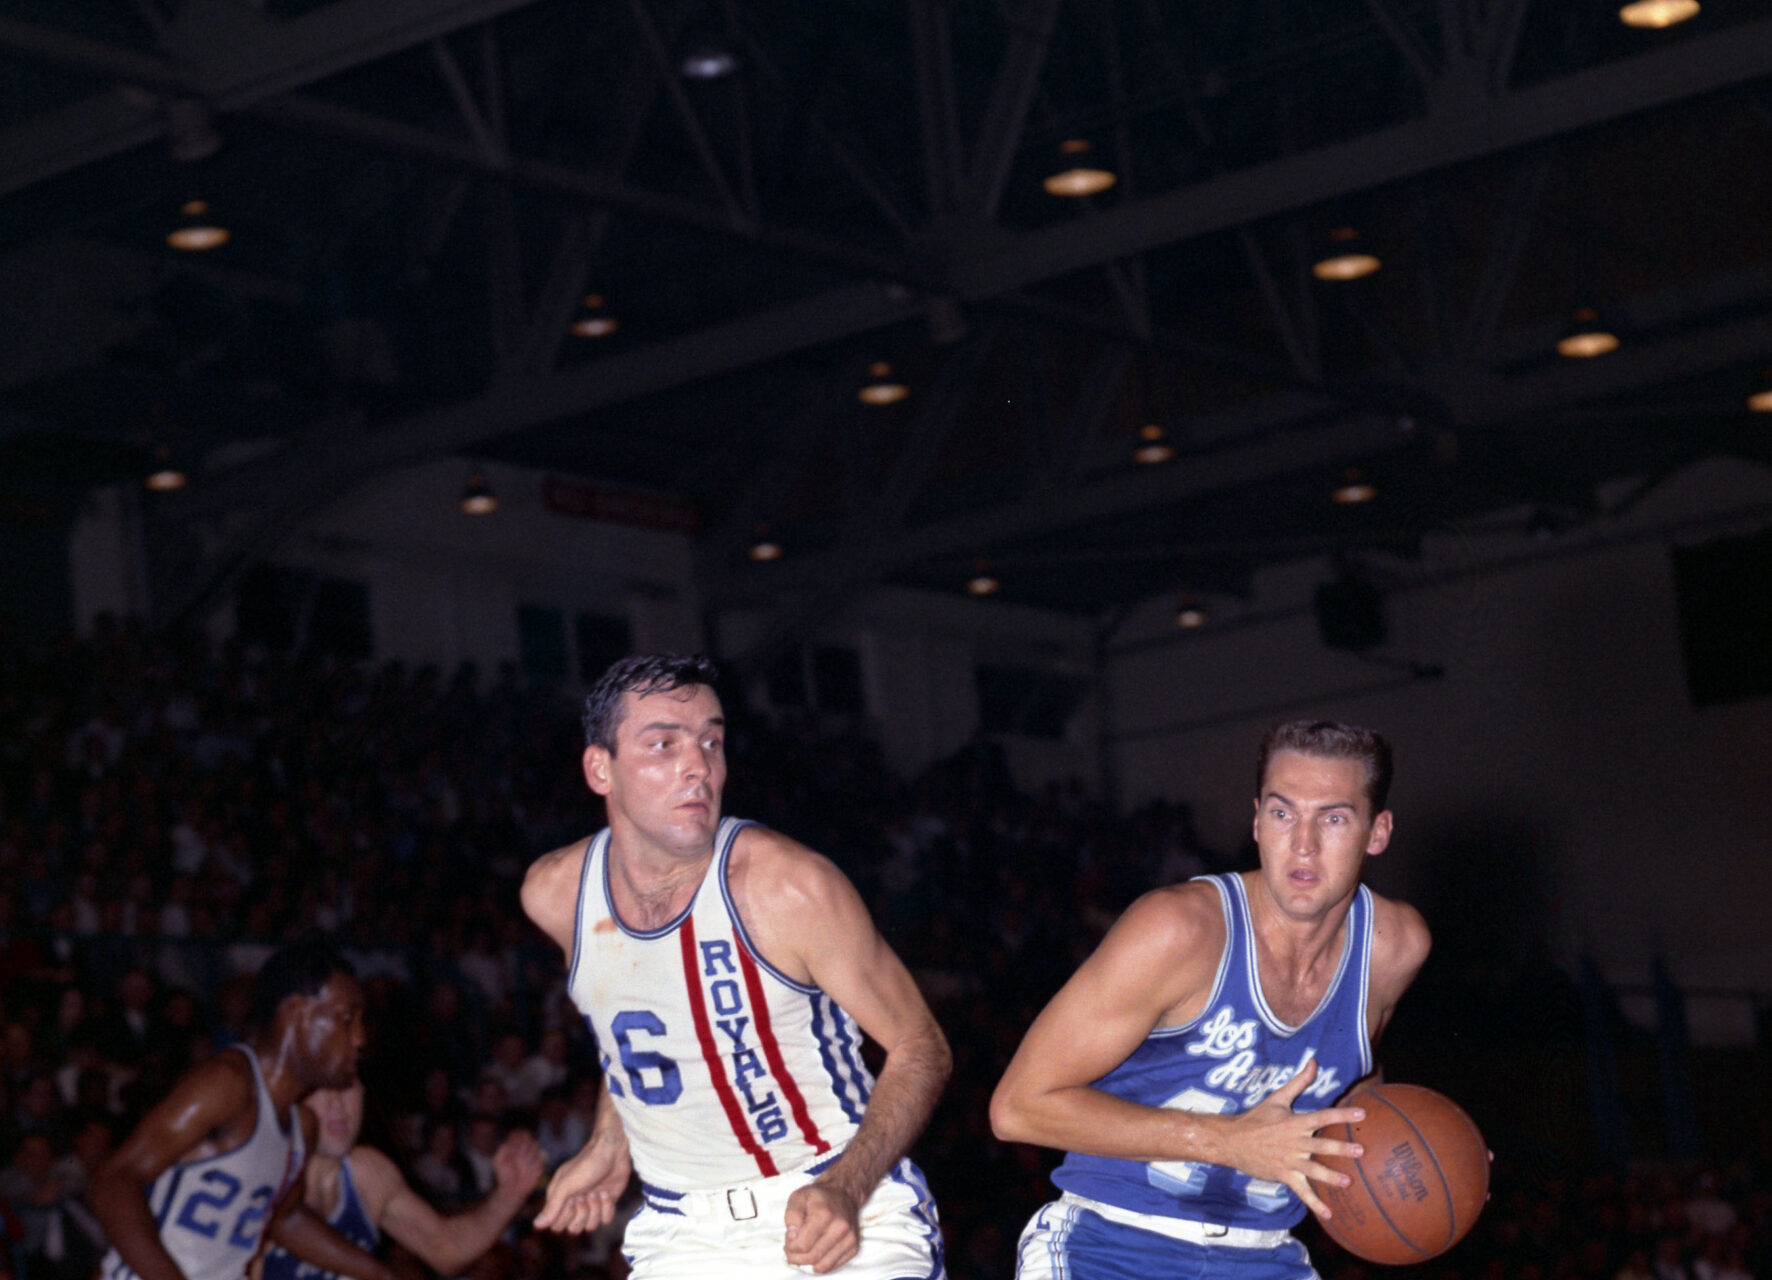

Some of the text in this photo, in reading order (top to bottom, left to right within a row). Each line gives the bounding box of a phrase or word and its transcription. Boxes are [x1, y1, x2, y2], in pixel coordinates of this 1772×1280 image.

[700, 939, 789, 1144] ROYALS
[1186, 1005, 1261, 1058] Los
[1392, 1141, 1429, 1202] Wilson
[176, 1169, 273, 1250] 22
